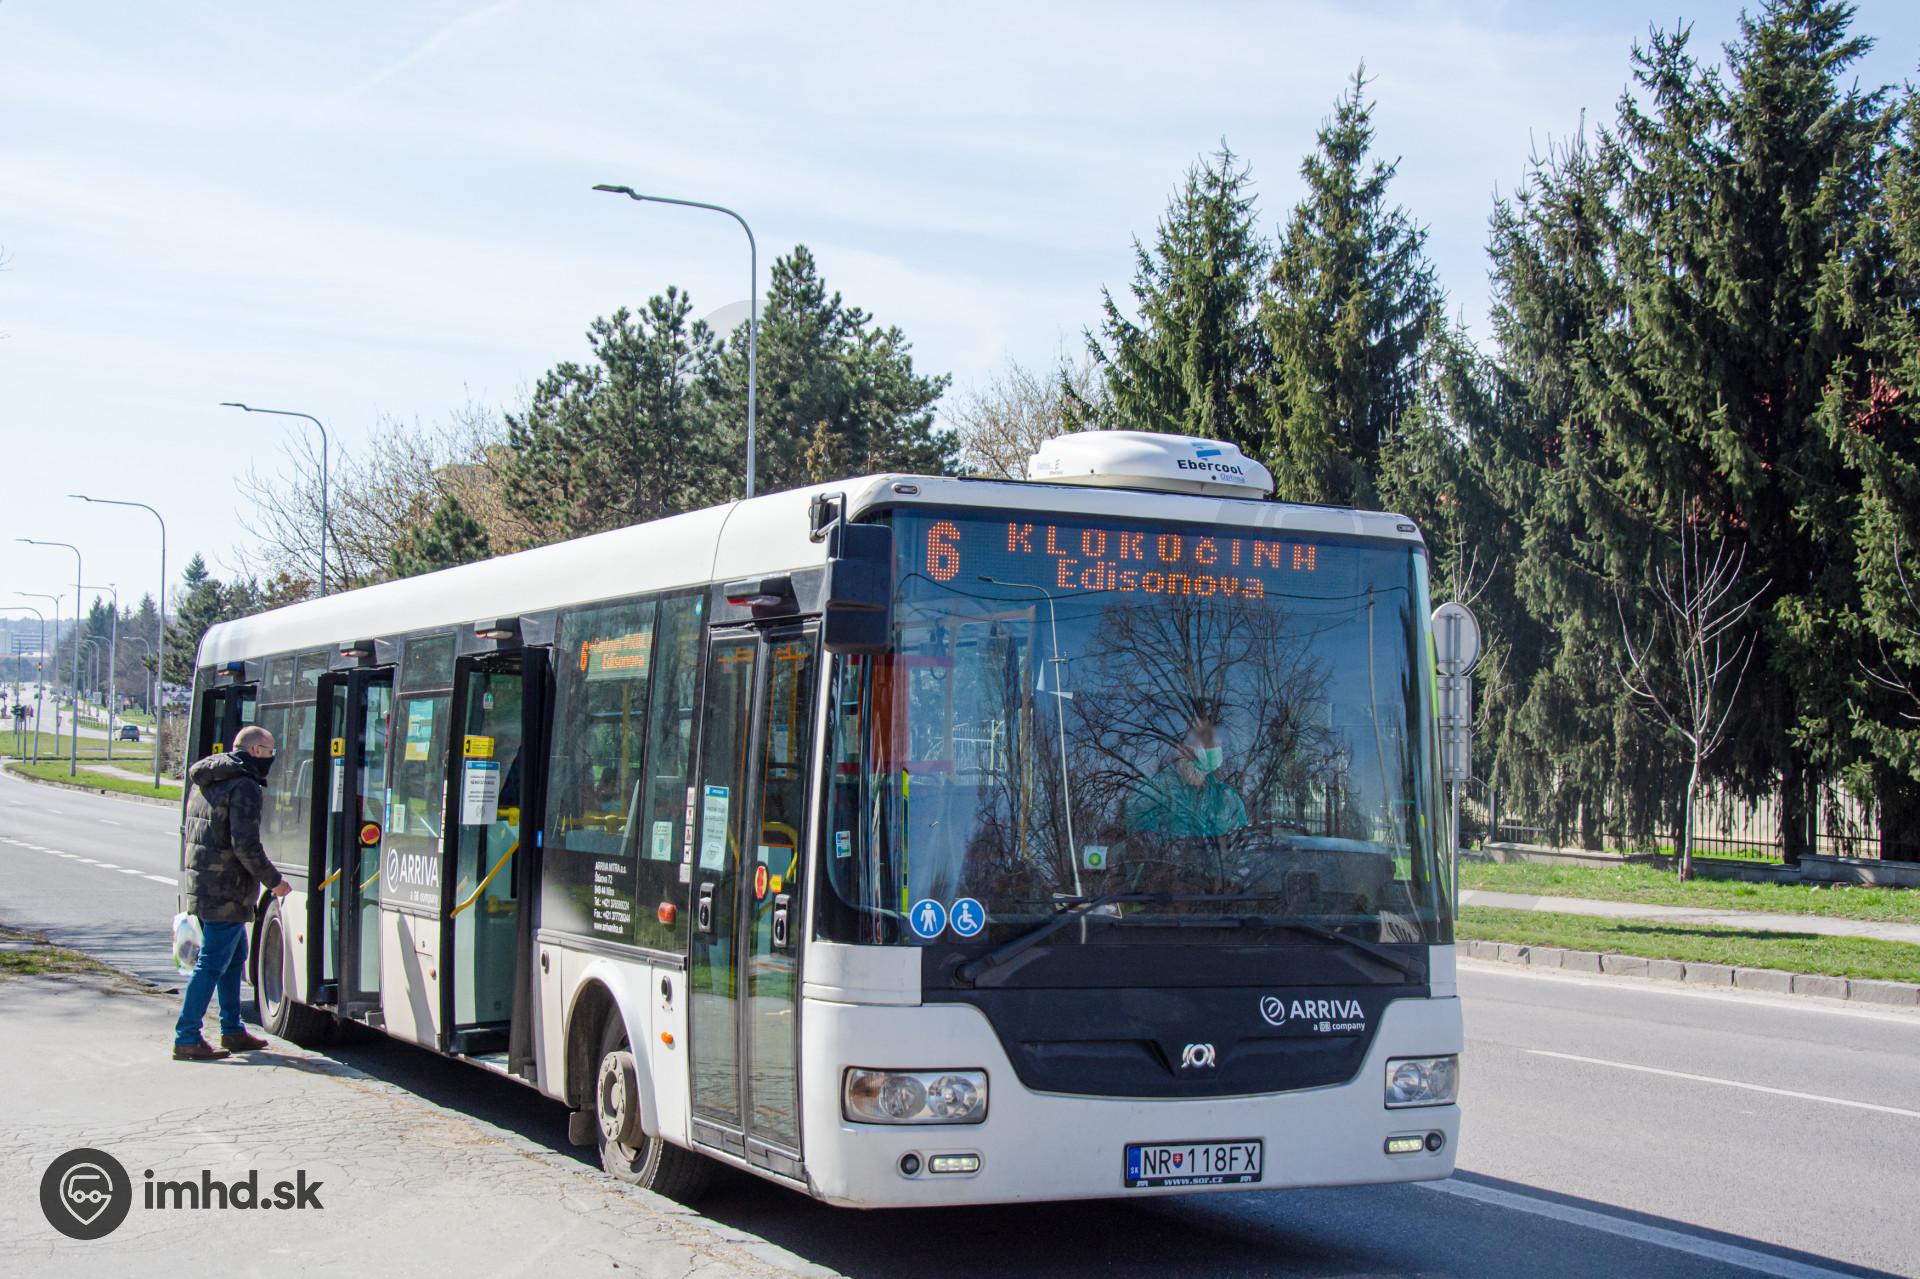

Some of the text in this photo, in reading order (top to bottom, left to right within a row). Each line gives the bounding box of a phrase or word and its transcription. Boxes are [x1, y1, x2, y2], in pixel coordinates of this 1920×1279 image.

[1176, 459, 1244, 476] Ebercool
[927, 521, 960, 580] 6
[1057, 558, 1266, 599] Edisonova
[399, 853, 439, 888] ARRIVA
[1289, 1000, 1365, 1020] ARRIVA
[1332, 1022, 1366, 1032] company
[1130, 1166, 1139, 1175] SK
[1143, 1145, 1257, 1176] NR 118FX
[1163, 1176, 1224, 1186] www.sor.cz
